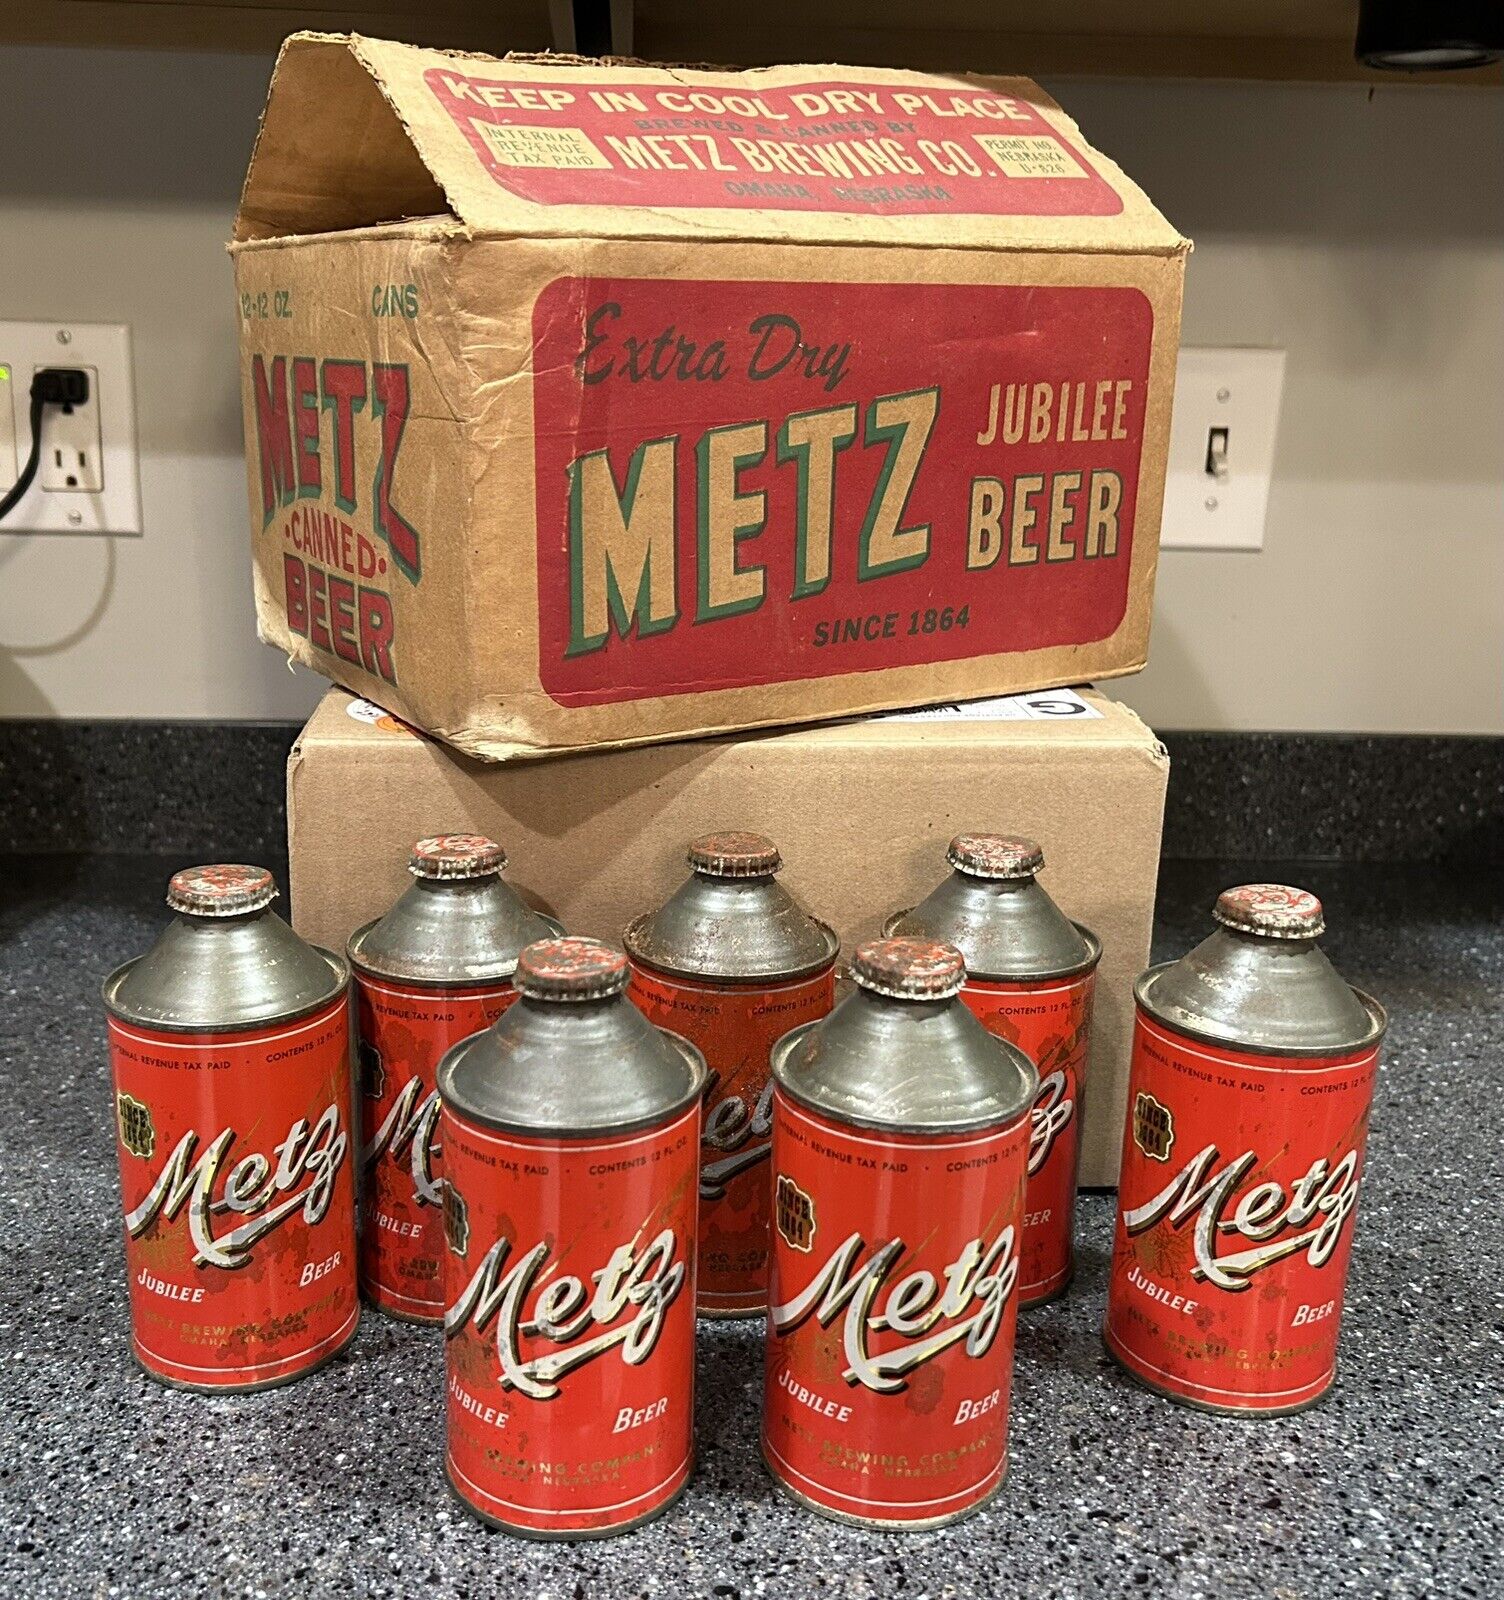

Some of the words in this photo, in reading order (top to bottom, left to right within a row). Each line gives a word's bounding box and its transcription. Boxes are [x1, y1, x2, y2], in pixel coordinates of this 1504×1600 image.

[441, 75, 576, 111] KEEP
[588, 91, 649, 113] IN
[655, 92, 789, 120] COOL
[788, 89, 887, 119] DRY
[893, 92, 1032, 121] PLACE
[486, 127, 580, 143] INTERNAL
[497, 140, 587, 155] REVENUE
[633, 118, 745, 134] BREWED
[754, 117, 775, 135] &
[783, 119, 879, 138] CANNED
[887, 120, 917, 133] BY
[984, 138, 1030, 151] PERMIT
[1033, 139, 1057, 151] NO.
[506, 151, 546, 165] TAX
[552, 154, 594, 166] PAID
[603, 134, 737, 172] METZ
[729, 135, 925, 180] BREWING
[916, 139, 997, 179] CO.
[998, 151, 1066, 163] NEBRASKA
[274, 290, 293, 319] OZ.
[371, 284, 419, 320] CANS
[579, 301, 731, 386] Extra
[747, 313, 853, 393] Dry
[976, 380, 1134, 447] JUBILEE
[251, 353, 422, 589] METZ
[289, 504, 378, 580] CANNED
[562, 384, 941, 661] METZ
[964, 468, 1124, 573] BEER
[283, 551, 399, 689] BEER
[812, 615, 896, 647] SINCE
[906, 604, 972, 636] 1864
[375, 1003, 410, 1019] REVENUE
[411, 1011, 429, 1021] TAX
[433, 1013, 455, 1022] PAID
[751, 1001, 797, 1015] CONTENTS
[998, 1005, 1047, 1016] CONTENTS
[1050, 1004, 1059, 1013] 12
[140, 1055, 180, 1070] REVENUE
[183, 1061, 202, 1070] TAX
[207, 1061, 231, 1070] PAID
[265, 1041, 314, 1063] CONTENTS
[316, 1035, 325, 1046] 12
[1172, 1061, 1213, 1083] REVENUE
[1216, 1076, 1236, 1089] TAX
[1240, 1081, 1266, 1093] PAID
[1300, 1081, 1348, 1096] CONTENTS
[1350, 1078, 1359, 1088] 12
[1137, 1097, 1170, 1132] SINCE
[460, 1143, 497, 1168] REVENUE
[500, 1159, 519, 1173] TAX
[523, 1164, 550, 1176] PAID
[589, 1156, 647, 1176] CONTENTS
[811, 1141, 853, 1165] REVENUE
[856, 1157, 877, 1169] TAX
[882, 1163, 908, 1173] PAID
[946, 1153, 998, 1172] CONTENTS
[1001, 1149, 1010, 1159] 12
[125, 1102, 347, 1271] Metz
[1022, 1208, 1052, 1228] EER
[1122, 1143, 1361, 1292] Metz
[136, 1266, 206, 1304] JUBILEE
[299, 1250, 341, 1288] BEER
[1127, 1266, 1200, 1316] JUBILEE
[1290, 1299, 1335, 1328] BEER
[445, 1227, 686, 1400] Metz
[772, 1224, 1020, 1392] Metz
[449, 1374, 510, 1429] JUBILEE
[611, 1396, 669, 1434] BEER
[778, 1368, 853, 1423] JUBILEE
[952, 1388, 1001, 1426] BEER
